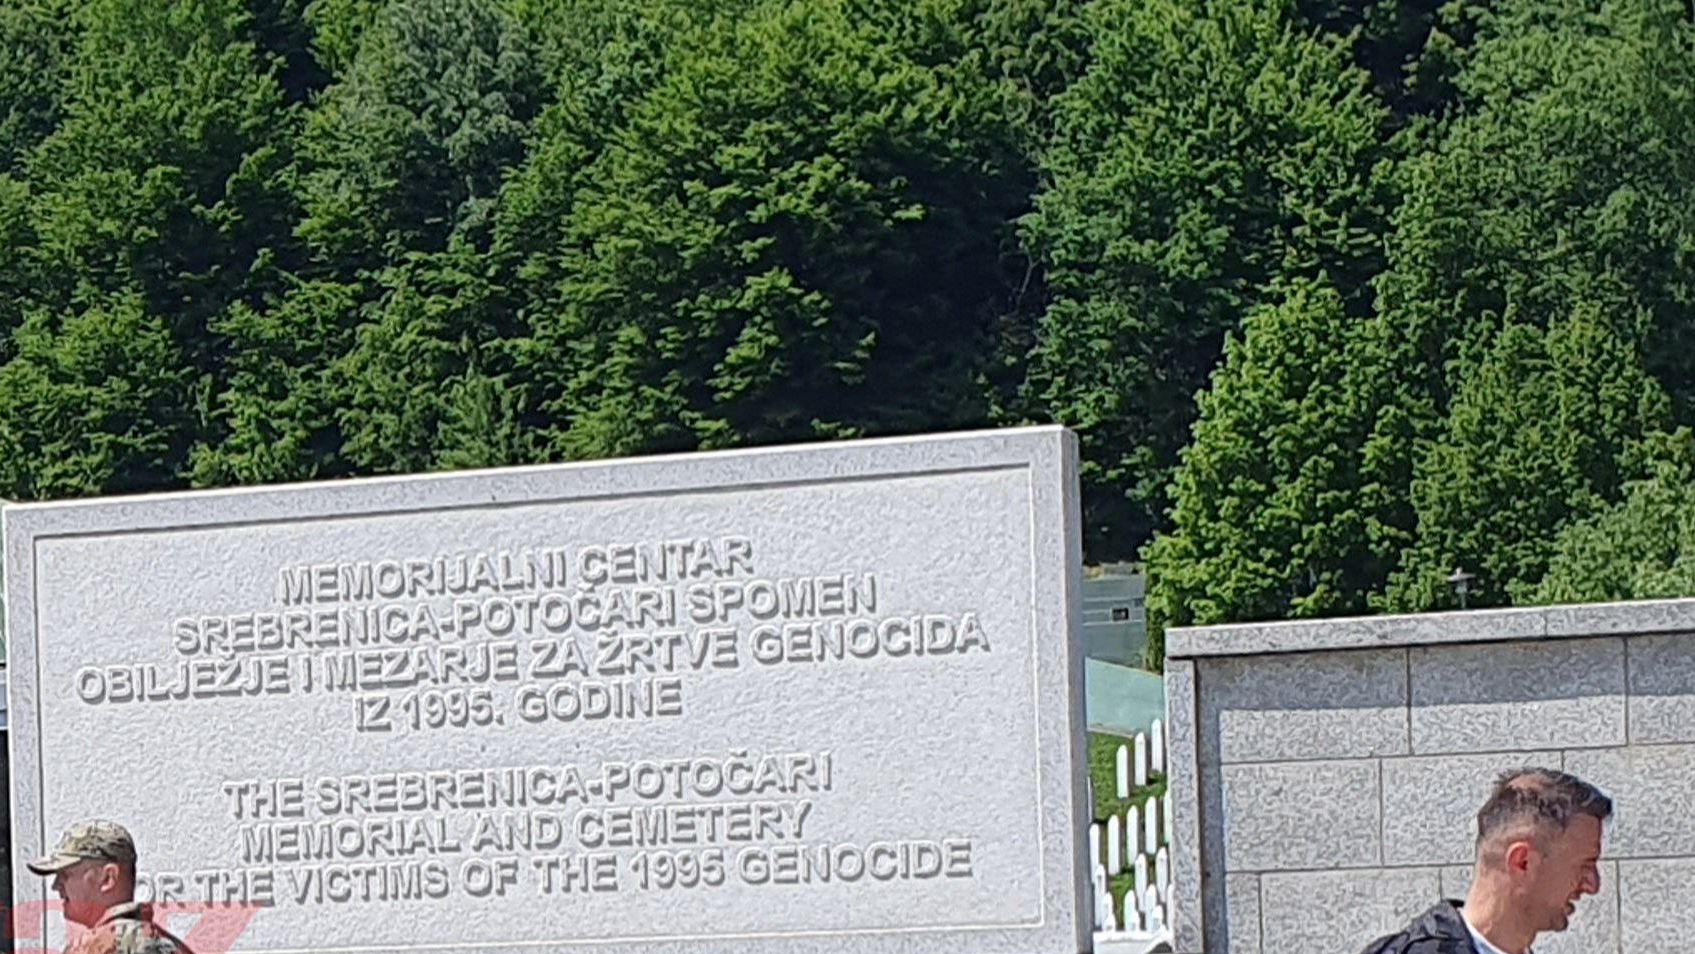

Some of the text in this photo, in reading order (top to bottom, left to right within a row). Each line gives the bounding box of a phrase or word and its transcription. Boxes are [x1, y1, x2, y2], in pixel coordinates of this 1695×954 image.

[277, 537, 754, 605] MEMORIJALNI CENTAR
[175, 574, 877, 654] SREBRENICA-POTOČARI SPOMEN
[77, 613, 991, 703] OBILJEŽJE I MEZARJE ZA ŽRTVE GENOCIDA
[355, 678, 682, 732] IZ 1995. GODINE
[224, 748, 832, 818] THE SREBRENICA-POTOČARI
[242, 801, 812, 863] MEMORIAL AND CEMETERY
[135, 839, 973, 908] OR THE VICTIMS OF THE 1995 GENOCIDE
